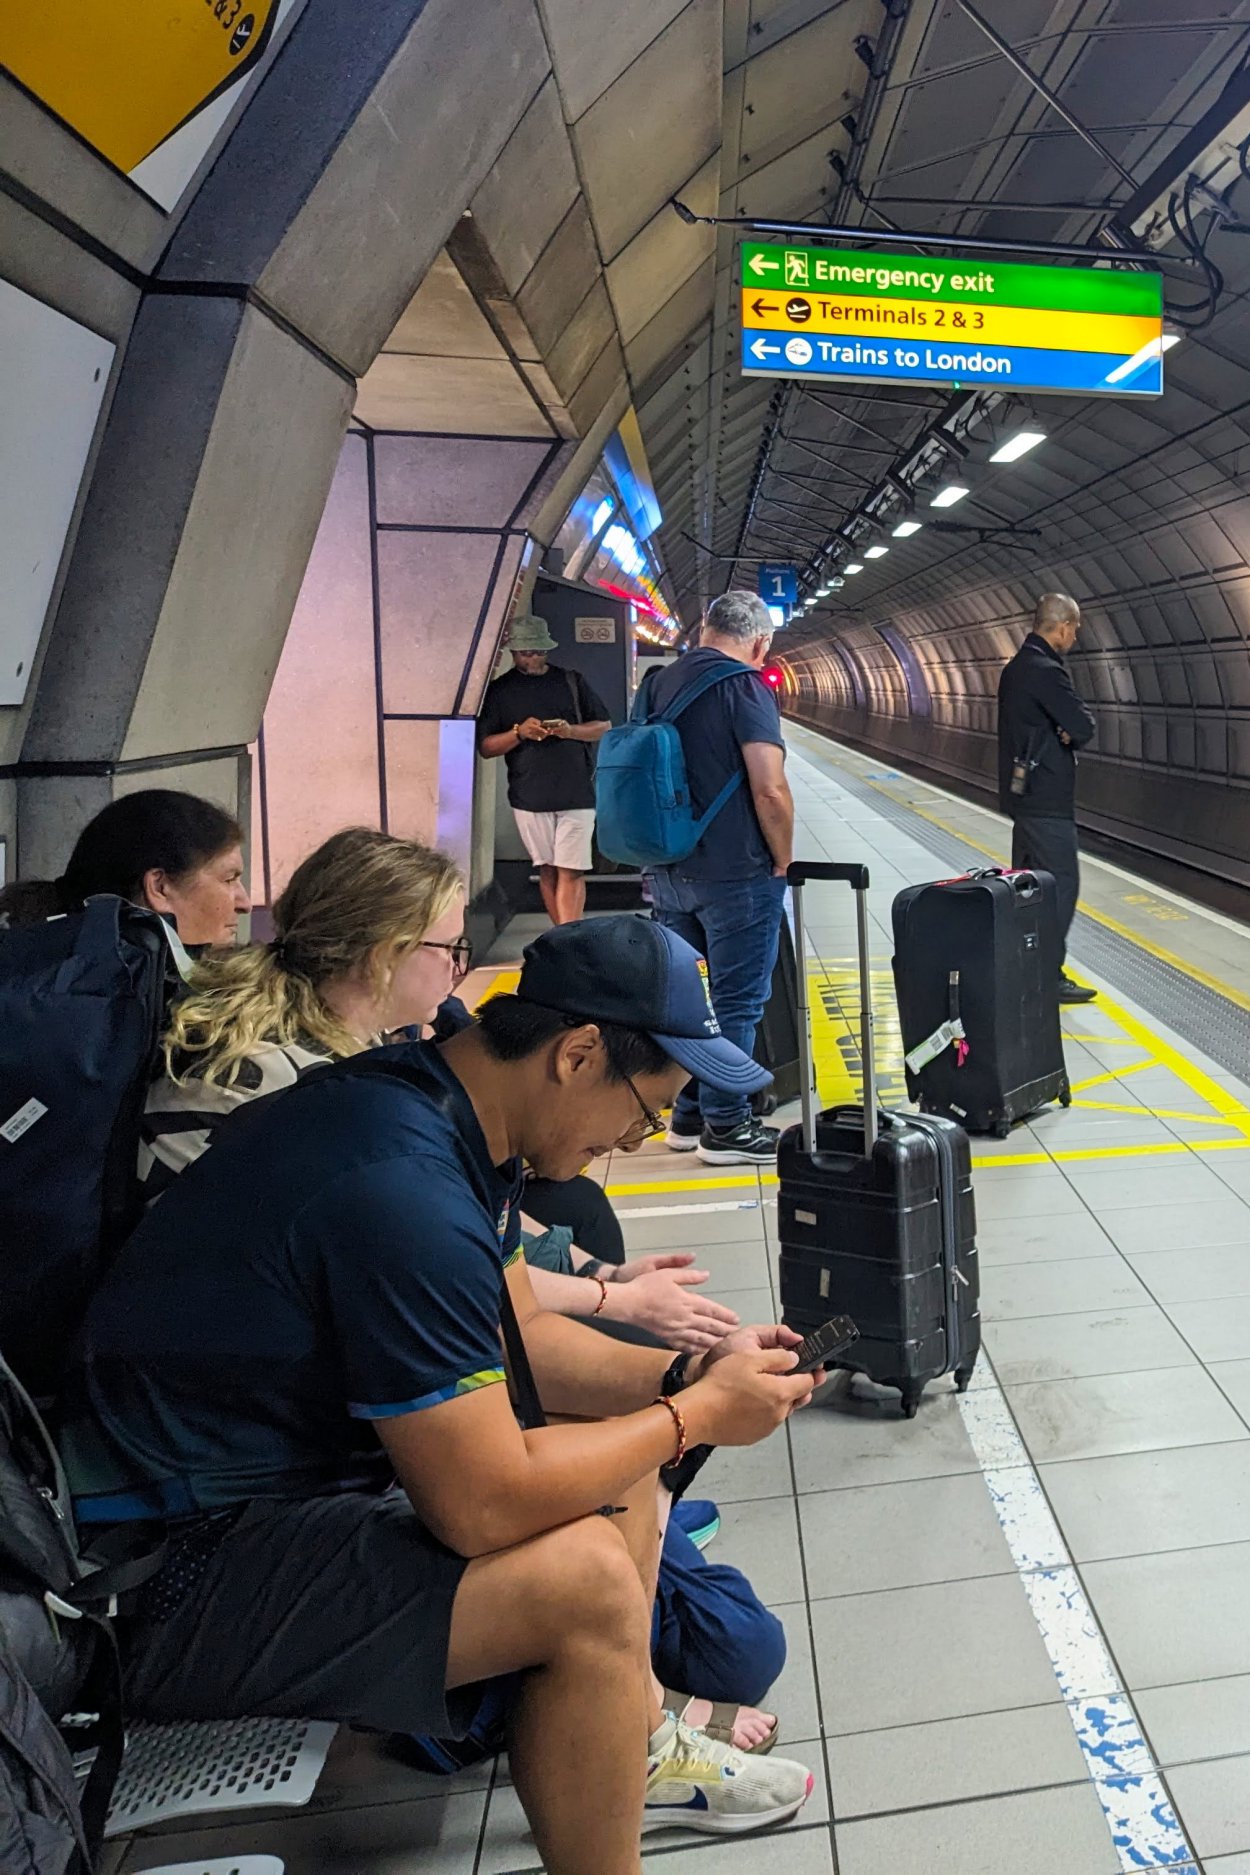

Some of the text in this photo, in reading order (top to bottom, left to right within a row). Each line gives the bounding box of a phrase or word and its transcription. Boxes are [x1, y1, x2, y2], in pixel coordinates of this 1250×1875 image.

[815, 260, 995, 293] Emergency exit
[818, 301, 985, 329] Terminals 2 & 3
[817, 341, 1012, 374] Trains to London
[772, 576, 786, 597] 1
